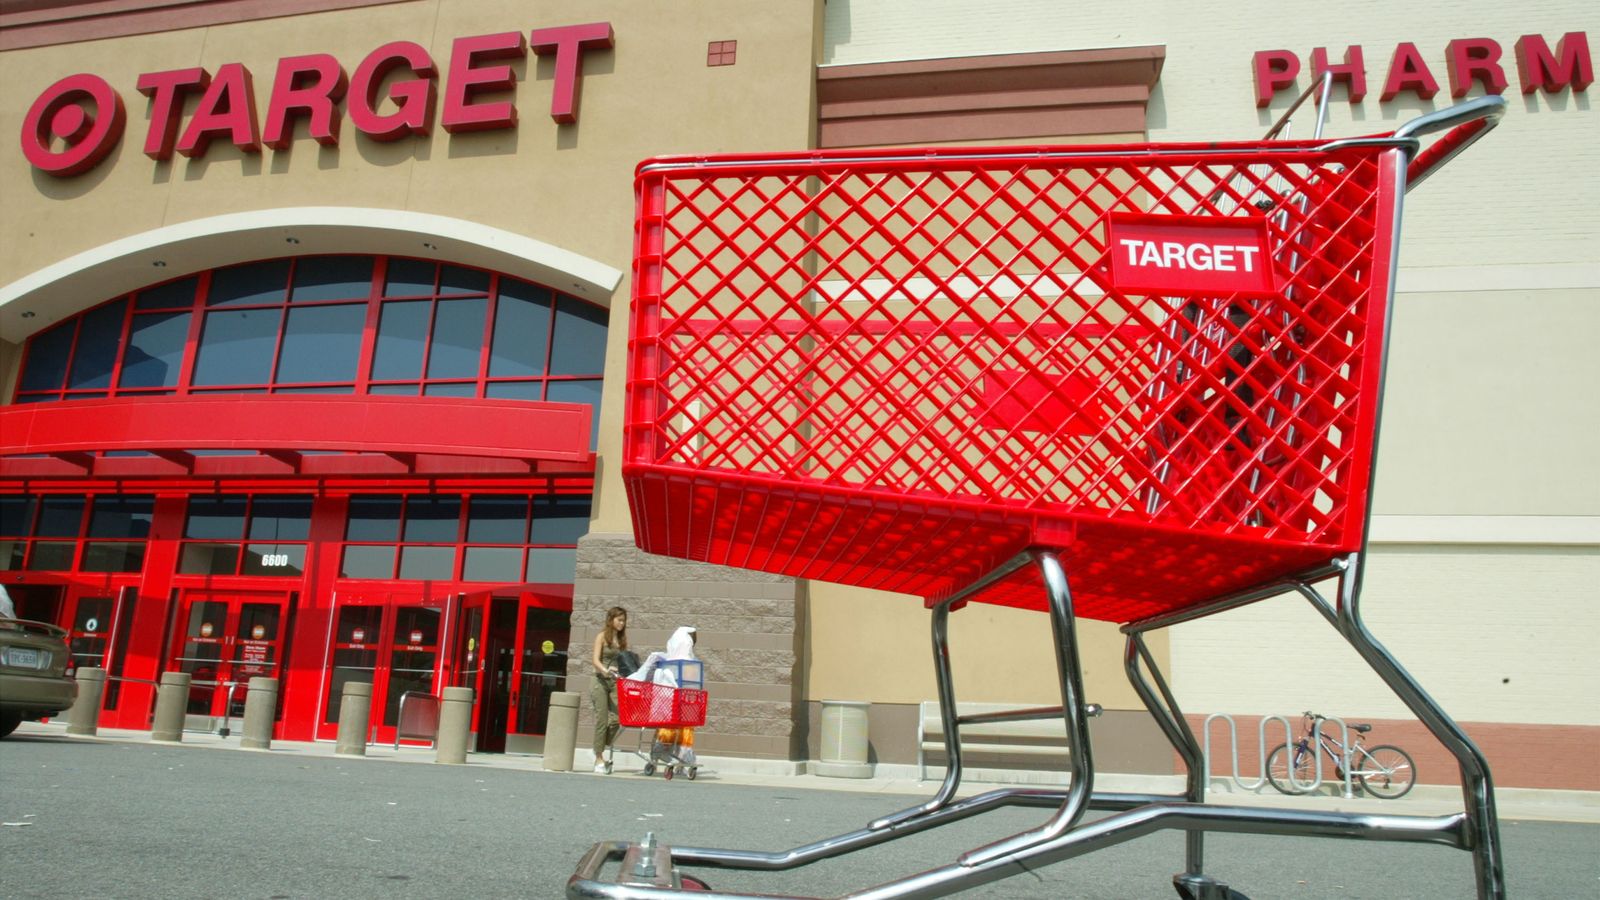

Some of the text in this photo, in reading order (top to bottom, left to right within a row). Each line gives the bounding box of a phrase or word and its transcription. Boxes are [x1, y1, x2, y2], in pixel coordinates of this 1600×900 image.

[137, 22, 614, 161] TARGET
[1251, 31, 1595, 109] PHARM
[1120, 239, 1259, 272] TARGET
[261, 554, 288, 567] 6600
